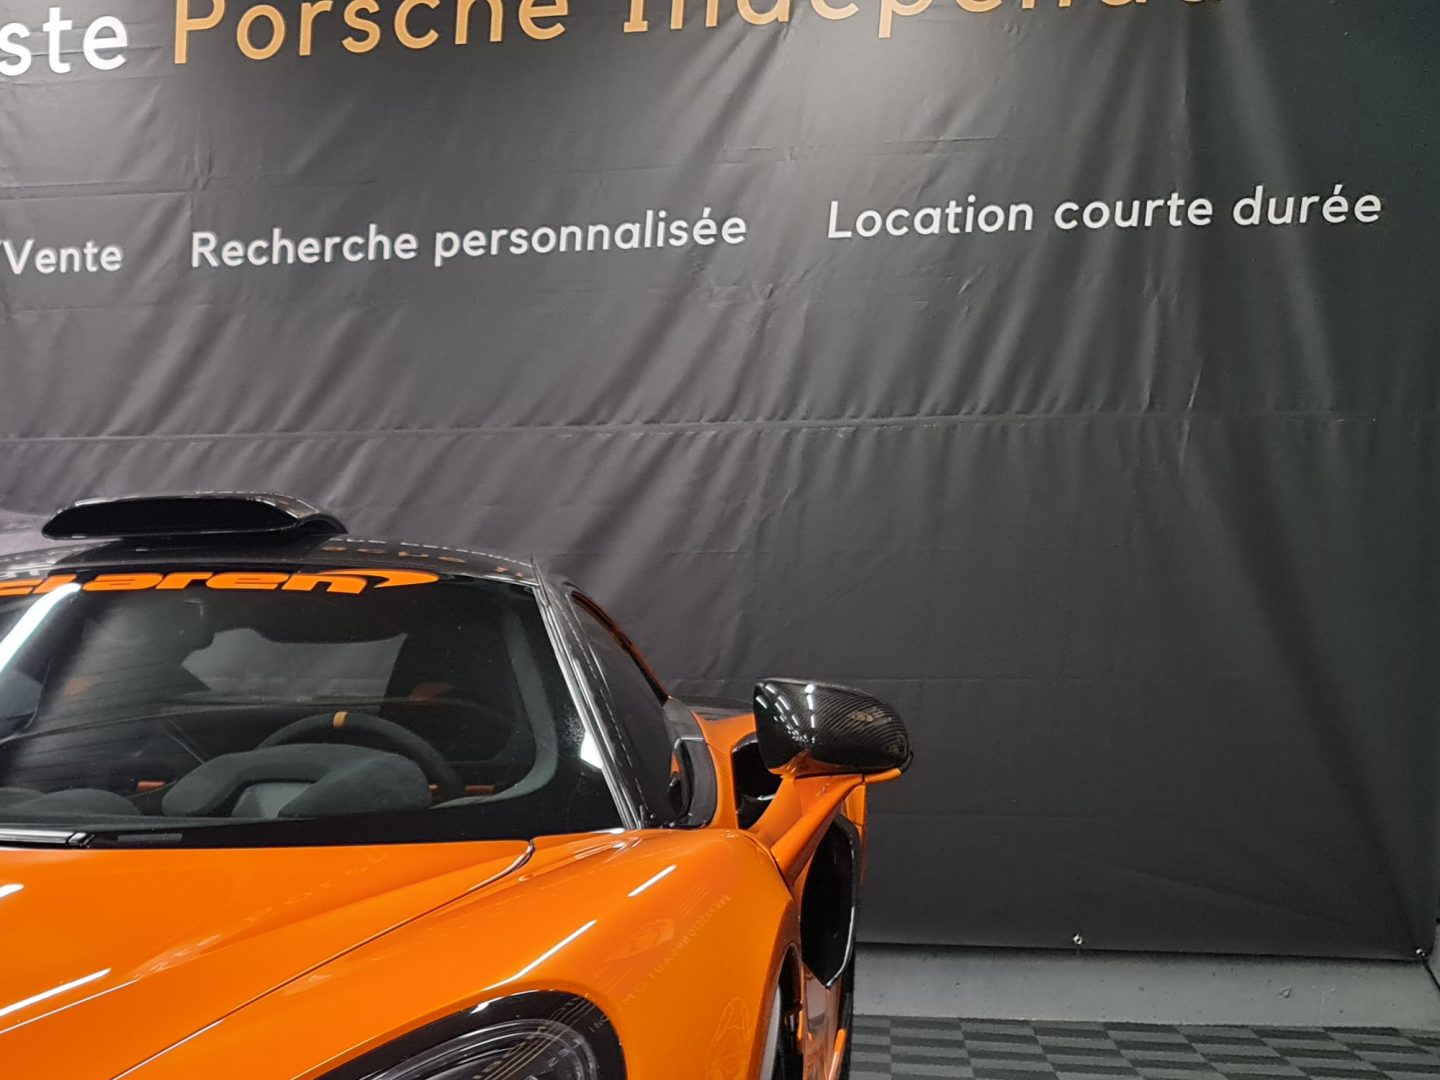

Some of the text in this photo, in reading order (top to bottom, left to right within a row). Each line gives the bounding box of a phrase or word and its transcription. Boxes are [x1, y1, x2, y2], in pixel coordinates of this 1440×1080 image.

[191, 207, 748, 269] Recherche personnalisée
[827, 183, 1383, 240] Location courte durée
